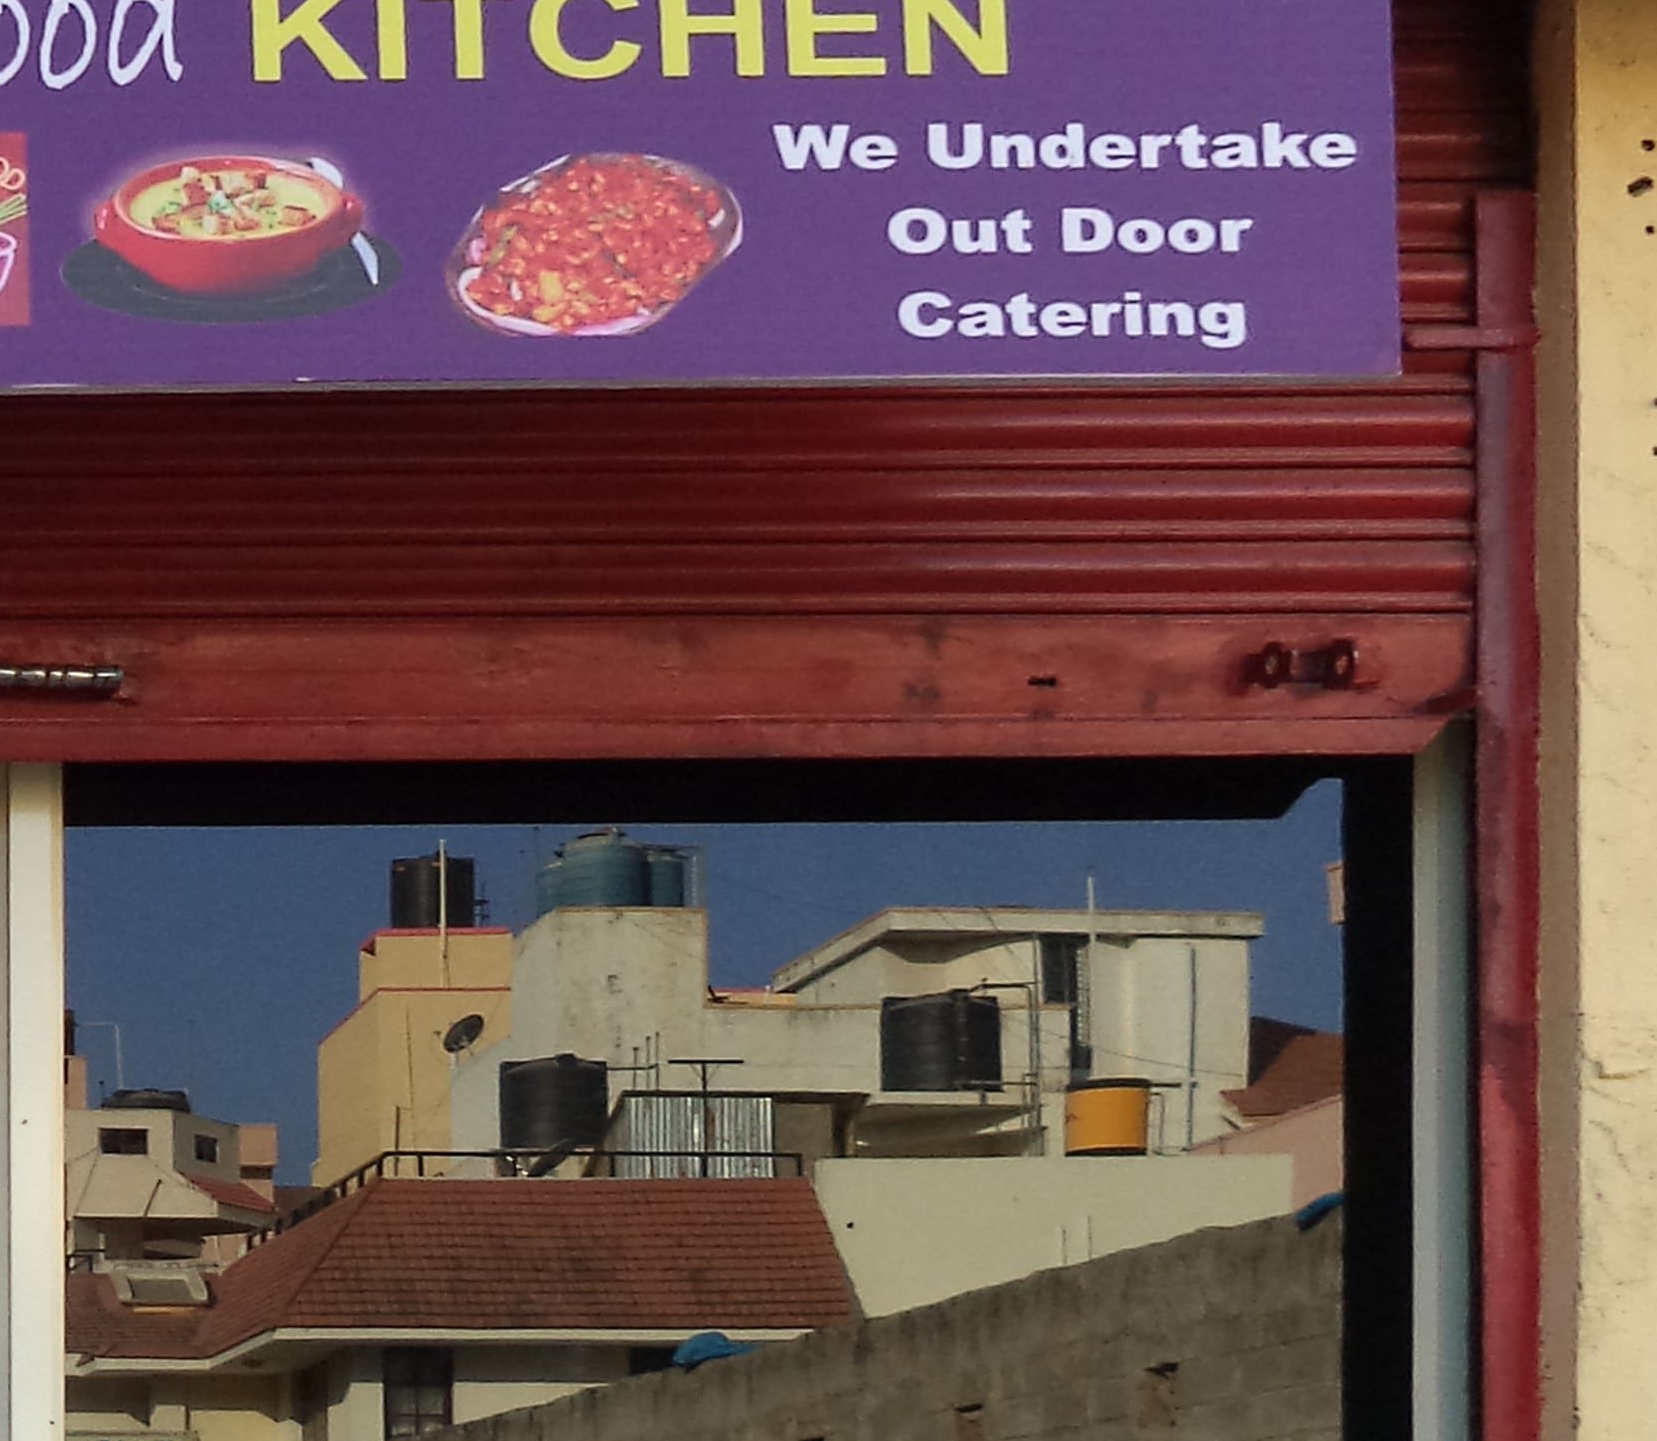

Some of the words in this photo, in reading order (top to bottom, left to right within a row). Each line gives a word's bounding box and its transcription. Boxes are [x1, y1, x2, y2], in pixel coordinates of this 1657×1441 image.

[773, 124, 898, 170] We
[928, 122, 1358, 169] Undertake
[888, 207, 1033, 254] Out
[1061, 207, 1254, 253] Door
[898, 291, 1247, 349] Catering
